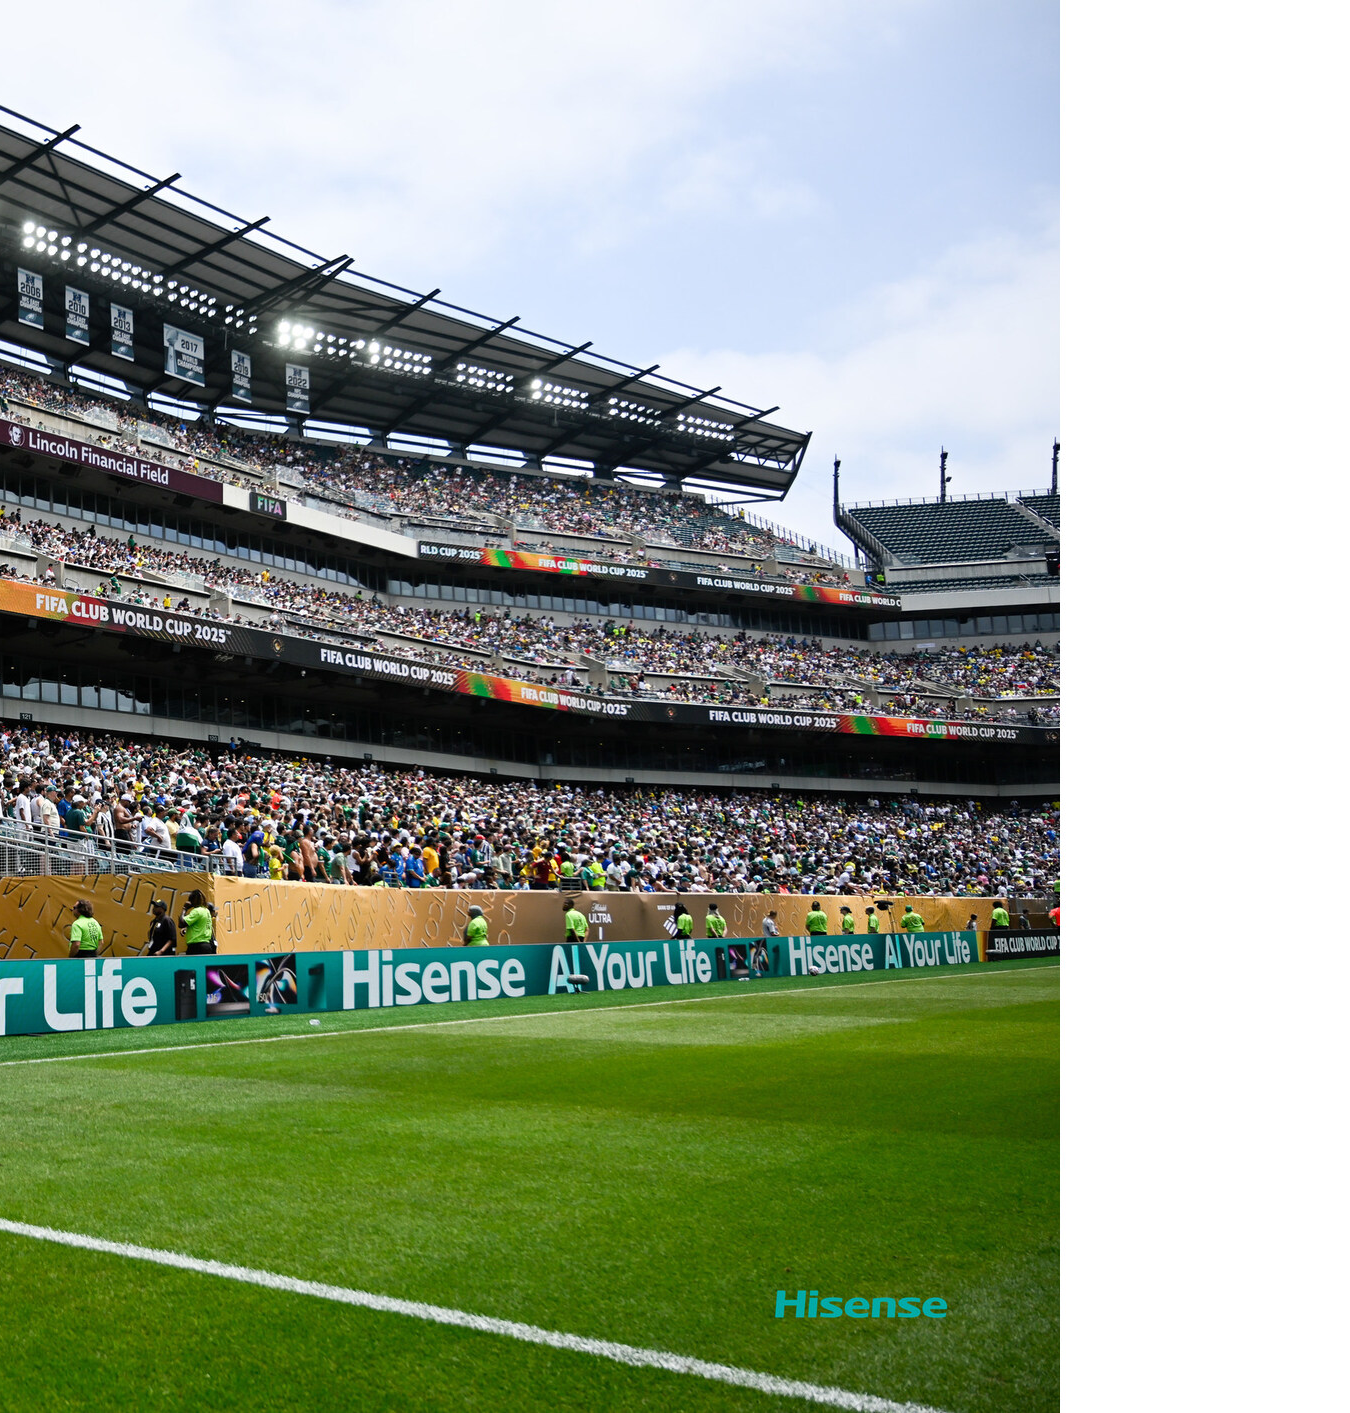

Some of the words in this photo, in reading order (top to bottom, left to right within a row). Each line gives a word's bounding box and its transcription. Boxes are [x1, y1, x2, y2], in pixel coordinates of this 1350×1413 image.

[20, 282, 41, 298] 2006
[181, 339, 198, 353] 2017
[28, 431, 78, 460] Lincoln
[81, 446, 138, 477] Financial
[140, 463, 169, 485] Field
[257, 497, 283, 517] FIFA
[439, 547, 457, 557] CUP
[538, 558, 556, 569] FIFA
[558, 560, 578, 572] CLUB
[580, 562, 608, 574] WORLD
[609, 566, 625, 577] CUP
[697, 576, 713, 587] FIFA
[714, 579, 733, 590] CLUB
[734, 581, 760, 592] WORLD
[761, 584, 775, 594] CUP
[839, 593, 854, 602] FIFA
[855, 594, 871, 604] CLUB
[872, 596, 895, 606] WORLD
[36, 593, 68, 615] FIFA
[71, 600, 109, 622] CLUB
[112, 608, 163, 631] WORLD
[165, 618, 192, 637] CUP
[320, 648, 344, 665] FIFA
[345, 653, 372, 670] CLUB
[373, 658, 409, 677] WORLD
[410, 666, 429, 681] CUP
[521, 687, 539, 701] FIFA
[539, 691, 559, 704] CLUB
[559, 694, 586, 709] WORLD
[587, 700, 601, 712] CUP
[709, 710, 731, 722] FIFA
[732, 711, 757, 723] CLUB
[758, 713, 792, 725] WORLD
[793, 716, 812, 726] CUP
[906, 722, 926, 734] FIFA
[926, 724, 948, 735] CLUB
[949, 725, 978, 737] WORLD
[979, 727, 995, 738] CUP
[588, 913, 612, 924] ULTRA
[994, 938, 1009, 953] FIFA
[1009, 937, 1025, 953] CLUB
[1024, 936, 1046, 952] WORLD
[1046, 935, 1058, 950] CUP
[788, 936, 874, 977] Hisense
[885, 934, 902, 969] AI
[903, 934, 941, 967] Your
[944, 931, 971, 964] Life
[342, 949, 526, 1009] Hisense
[548, 945, 582, 995] AI
[586, 944, 657, 991] Your
[663, 940, 712, 985] Life
[44, 958, 158, 1031] Life
